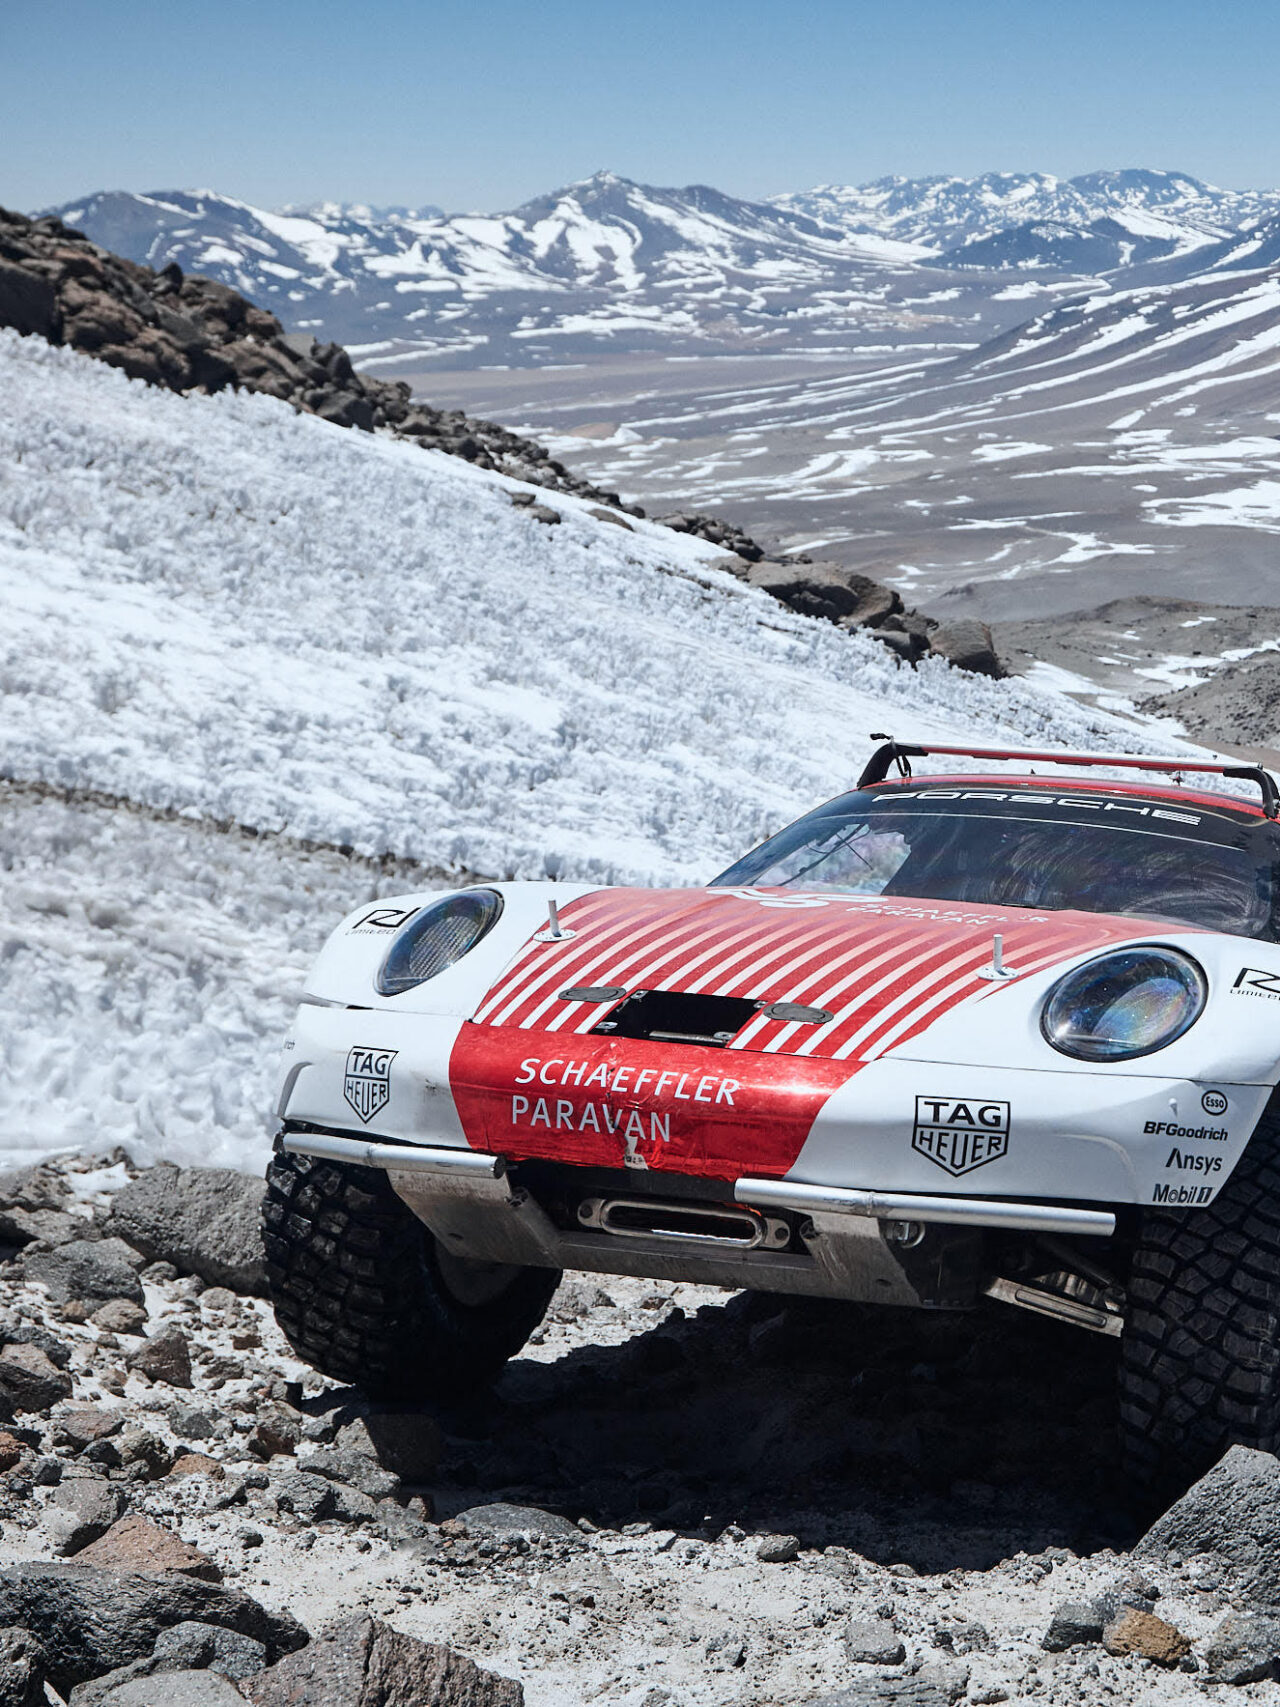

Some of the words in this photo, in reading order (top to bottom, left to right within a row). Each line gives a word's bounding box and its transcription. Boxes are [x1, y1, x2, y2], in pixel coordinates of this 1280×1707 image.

[872, 791, 1201, 826] PORSCHE
[846, 906, 988, 925] PARAVAN
[352, 1052, 389, 1075] TAG
[515, 1058, 740, 1105] SCHAEFFLER
[346, 1080, 386, 1117] HEUER
[1206, 1096, 1225, 1109] Esso
[512, 1095, 670, 1142] PARAVAN
[924, 1101, 1002, 1127] TAG
[1143, 1121, 1229, 1141] BFGoodrich
[919, 1130, 1002, 1170] HEUER
[1165, 1148, 1223, 1176] Ansys
[1152, 1184, 1198, 1204] Mobil
